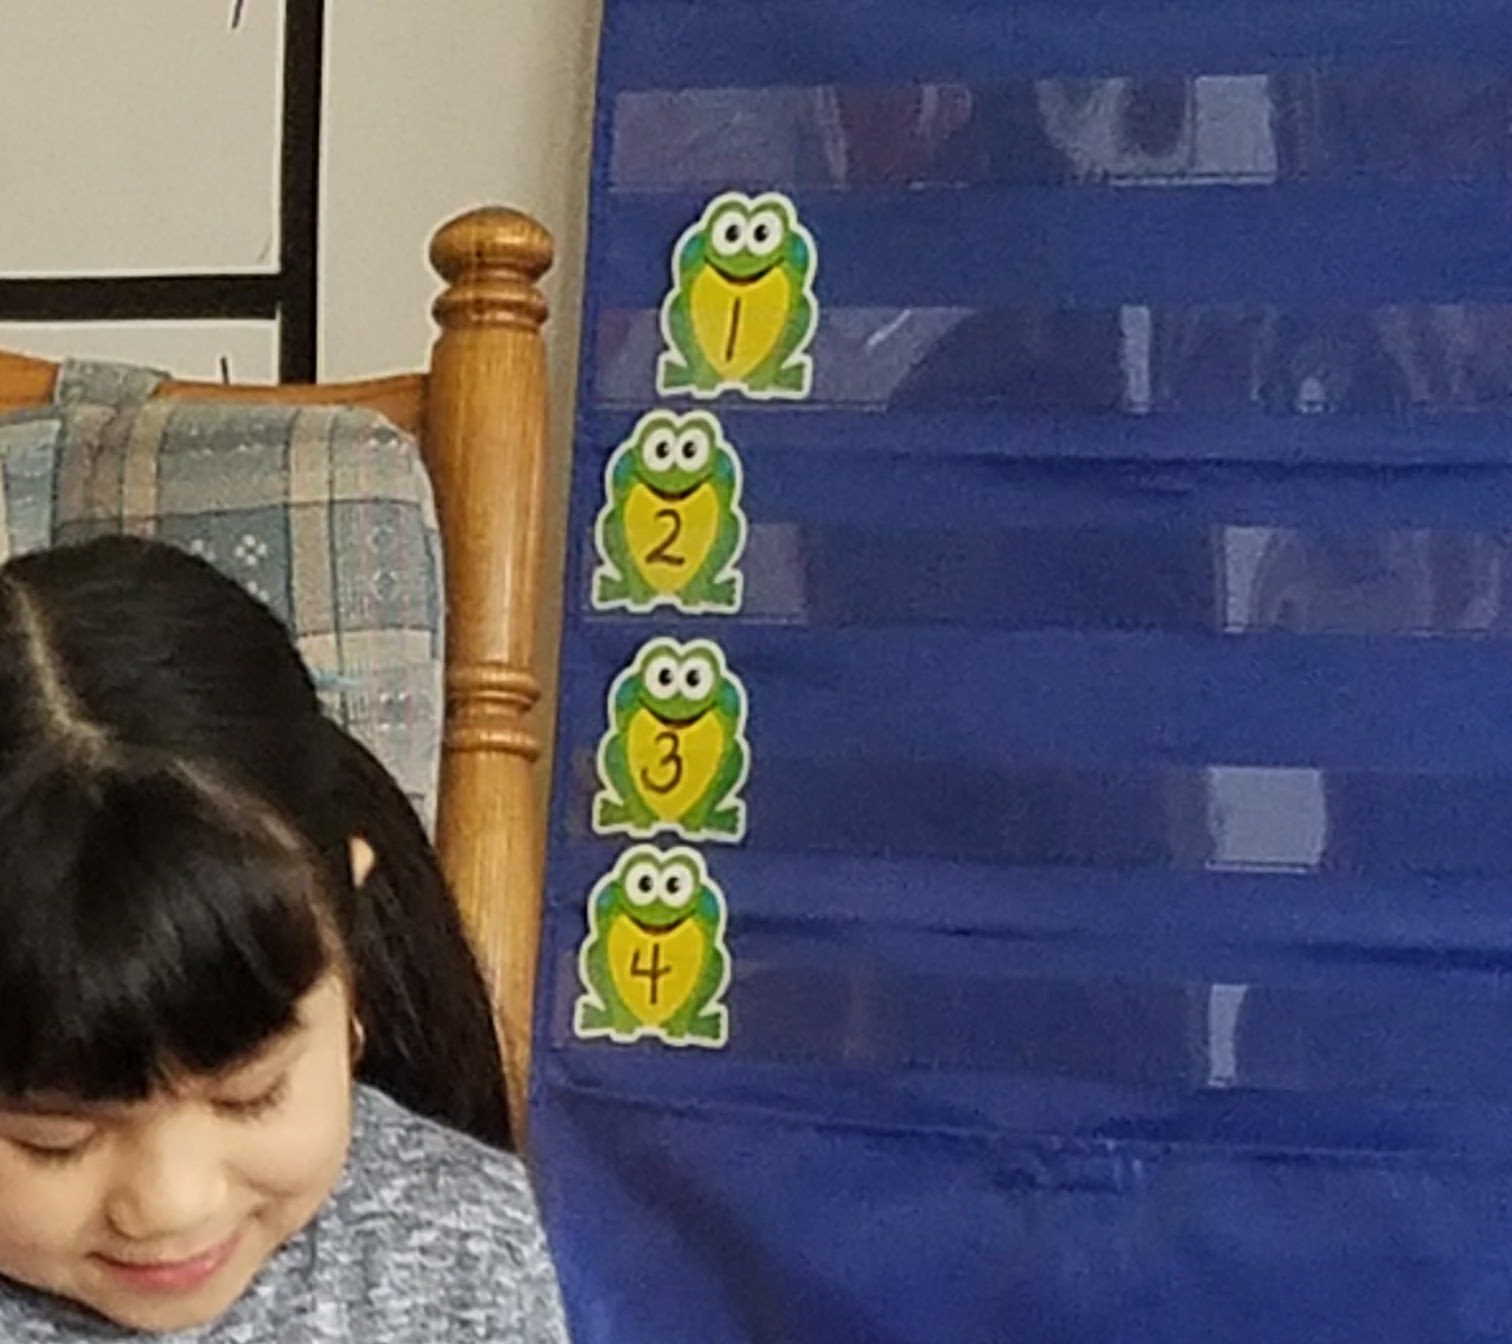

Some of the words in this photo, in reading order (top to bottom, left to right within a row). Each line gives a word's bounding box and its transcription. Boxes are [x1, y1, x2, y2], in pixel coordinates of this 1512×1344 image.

[724, 296, 742, 364] 1
[644, 508, 686, 567] 2
[640, 730, 684, 795] 3
[629, 942, 672, 1006] 4
